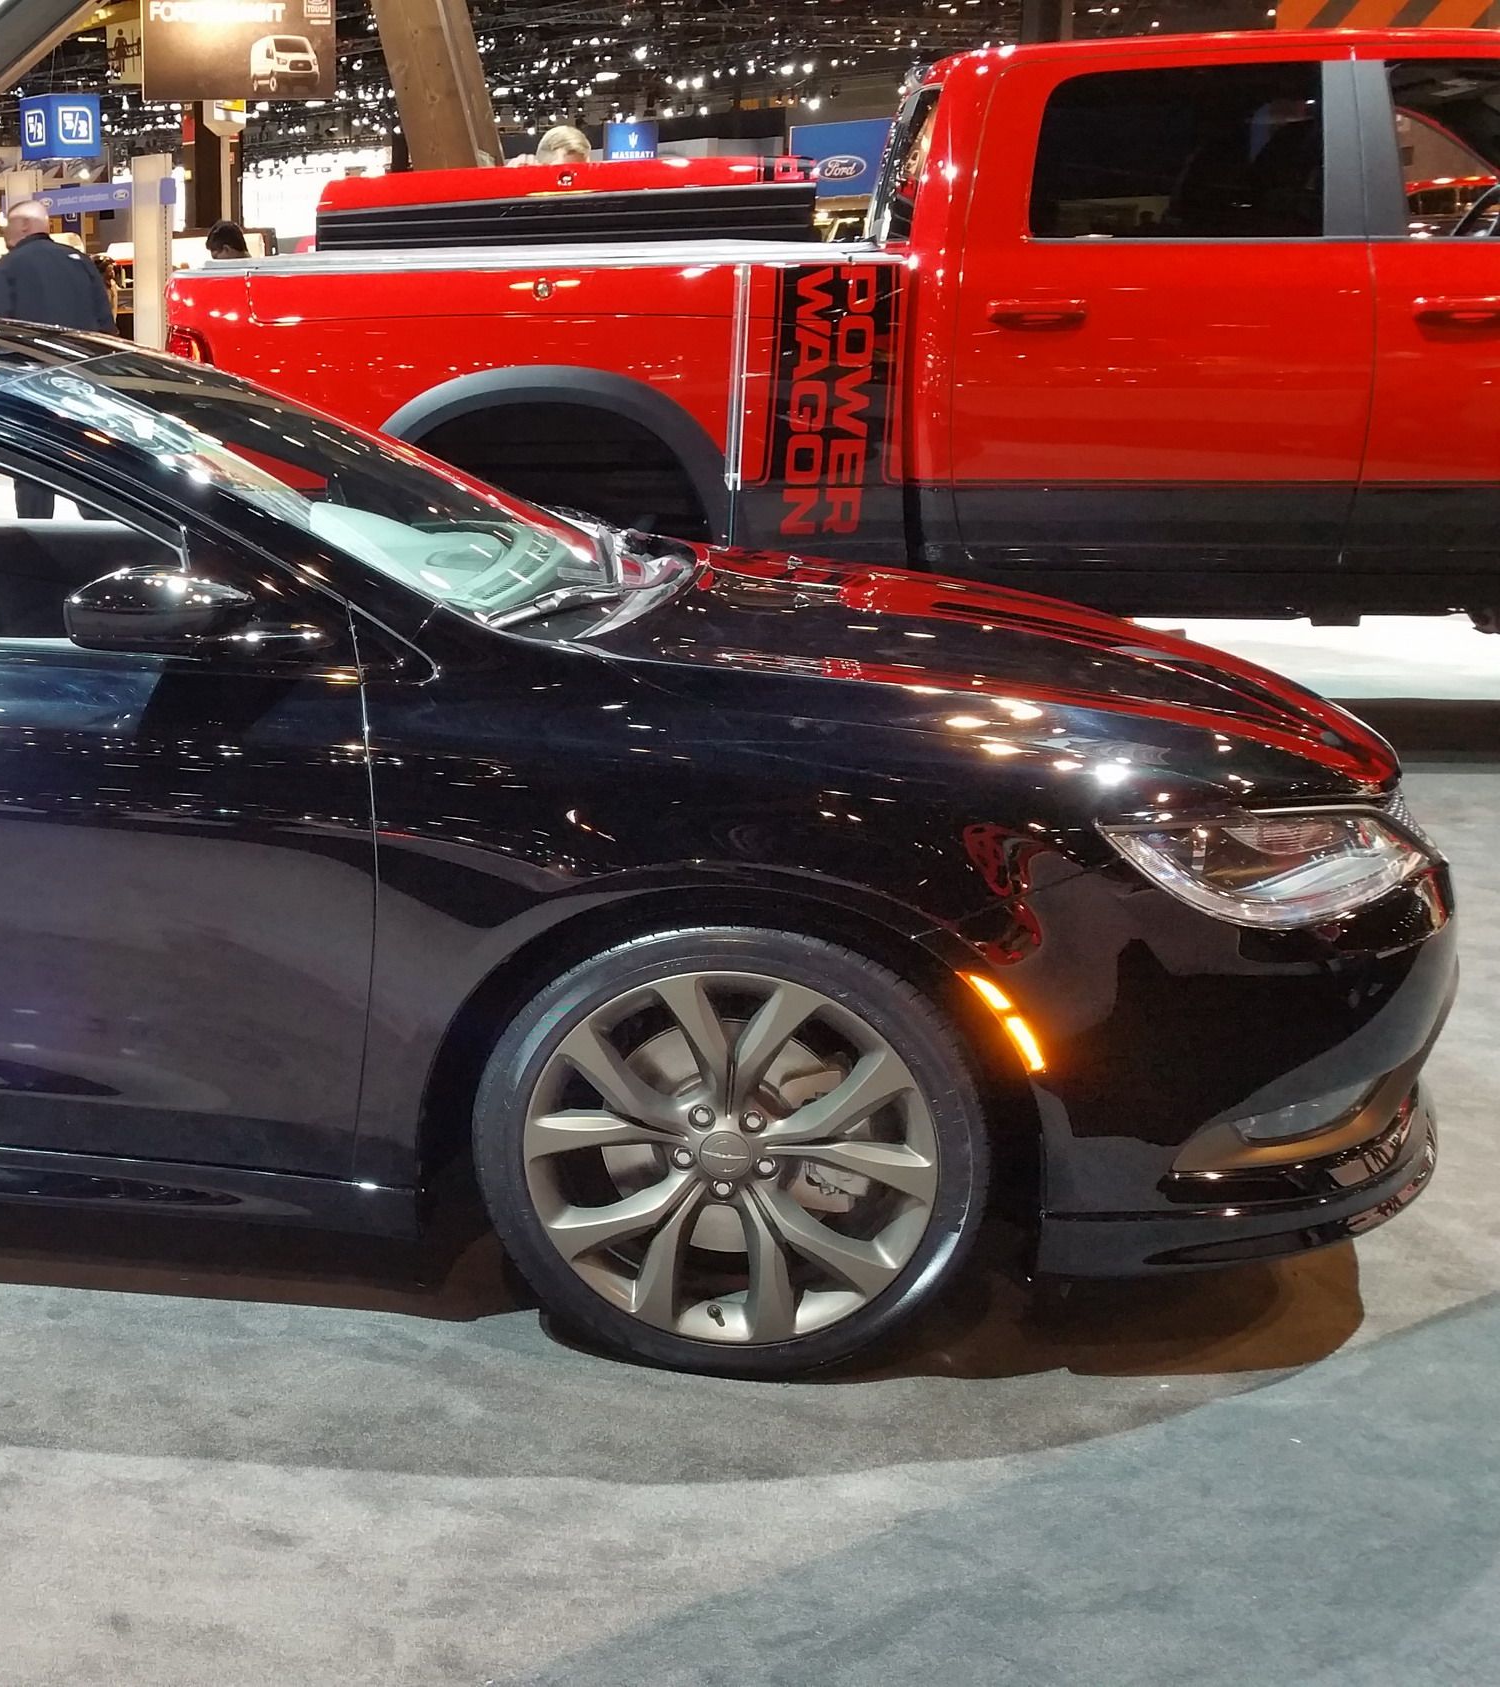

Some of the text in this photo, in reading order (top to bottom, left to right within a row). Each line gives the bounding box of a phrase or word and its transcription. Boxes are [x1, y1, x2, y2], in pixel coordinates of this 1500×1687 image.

[611, 151, 654, 159] MASERATI
[824, 159, 857, 177] Ford
[780, 266, 835, 535] WAGON
[821, 266, 878, 533] POWER
